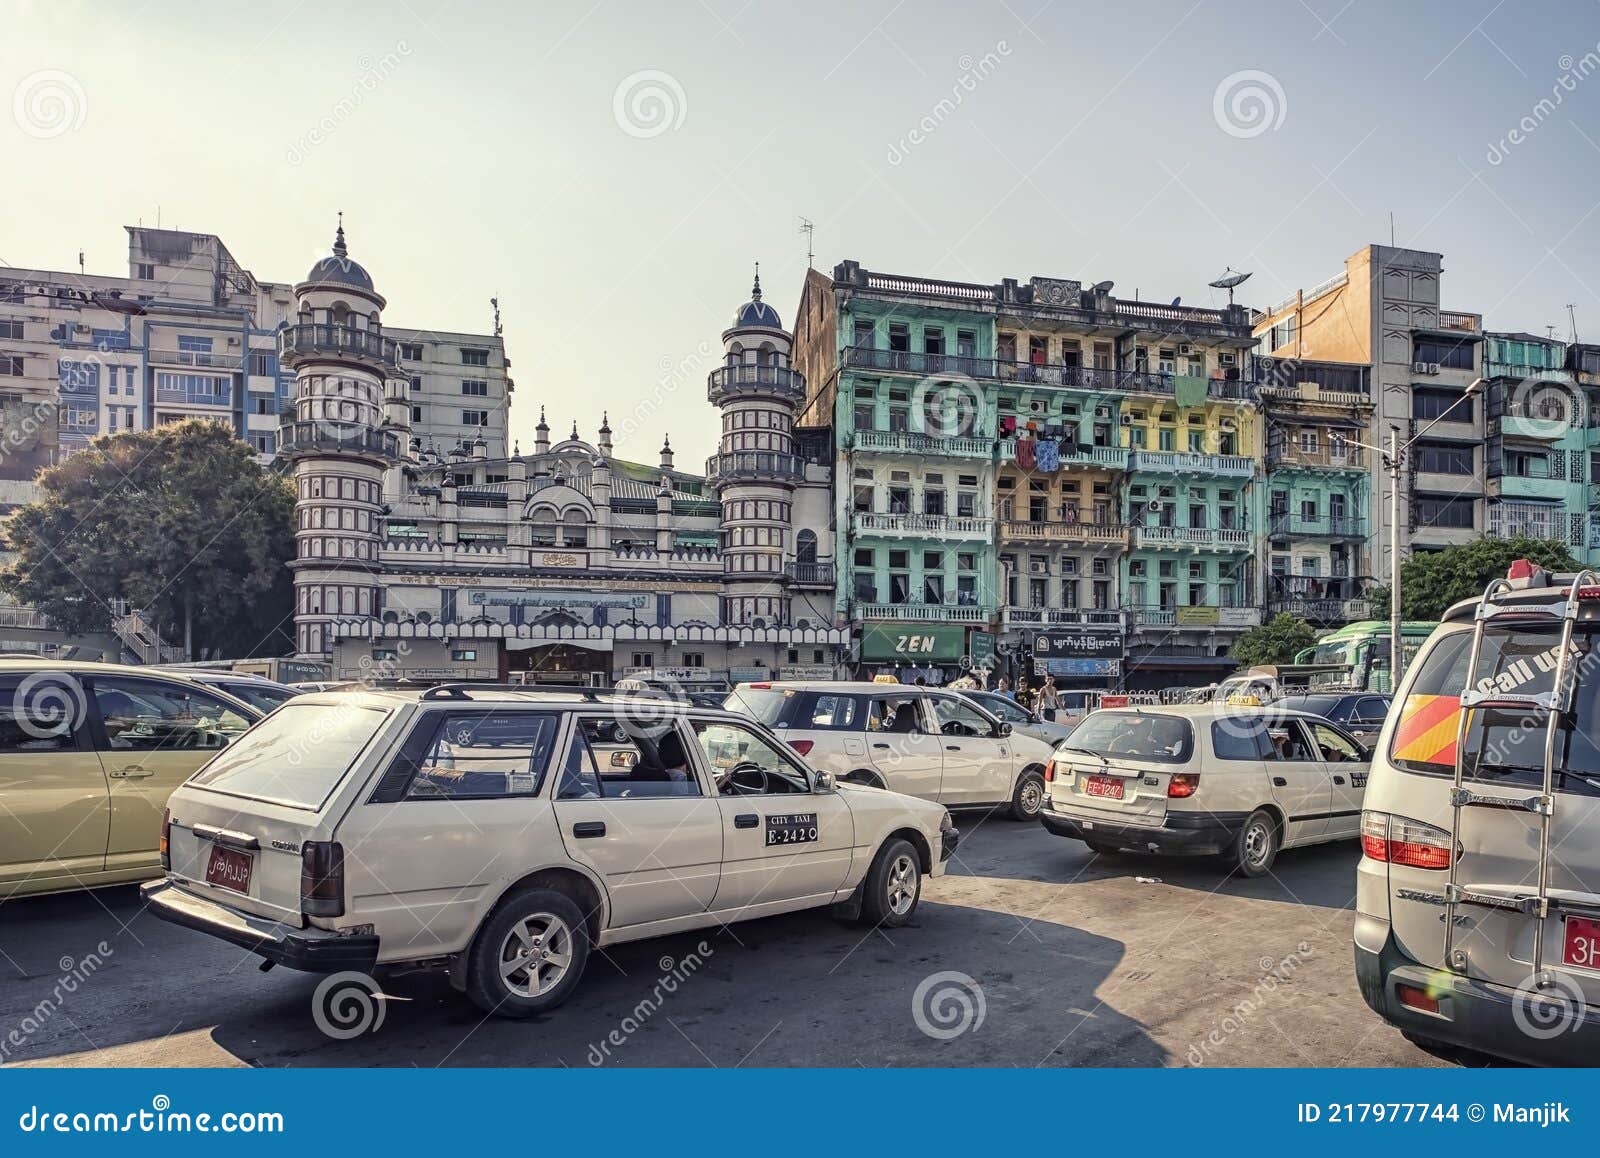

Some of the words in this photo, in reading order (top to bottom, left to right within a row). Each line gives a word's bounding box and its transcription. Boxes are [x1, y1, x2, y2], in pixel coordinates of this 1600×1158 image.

[896, 635, 935, 653] ZEN
[771, 816, 789, 825] CITY
[793, 814, 810, 823] TAXI
